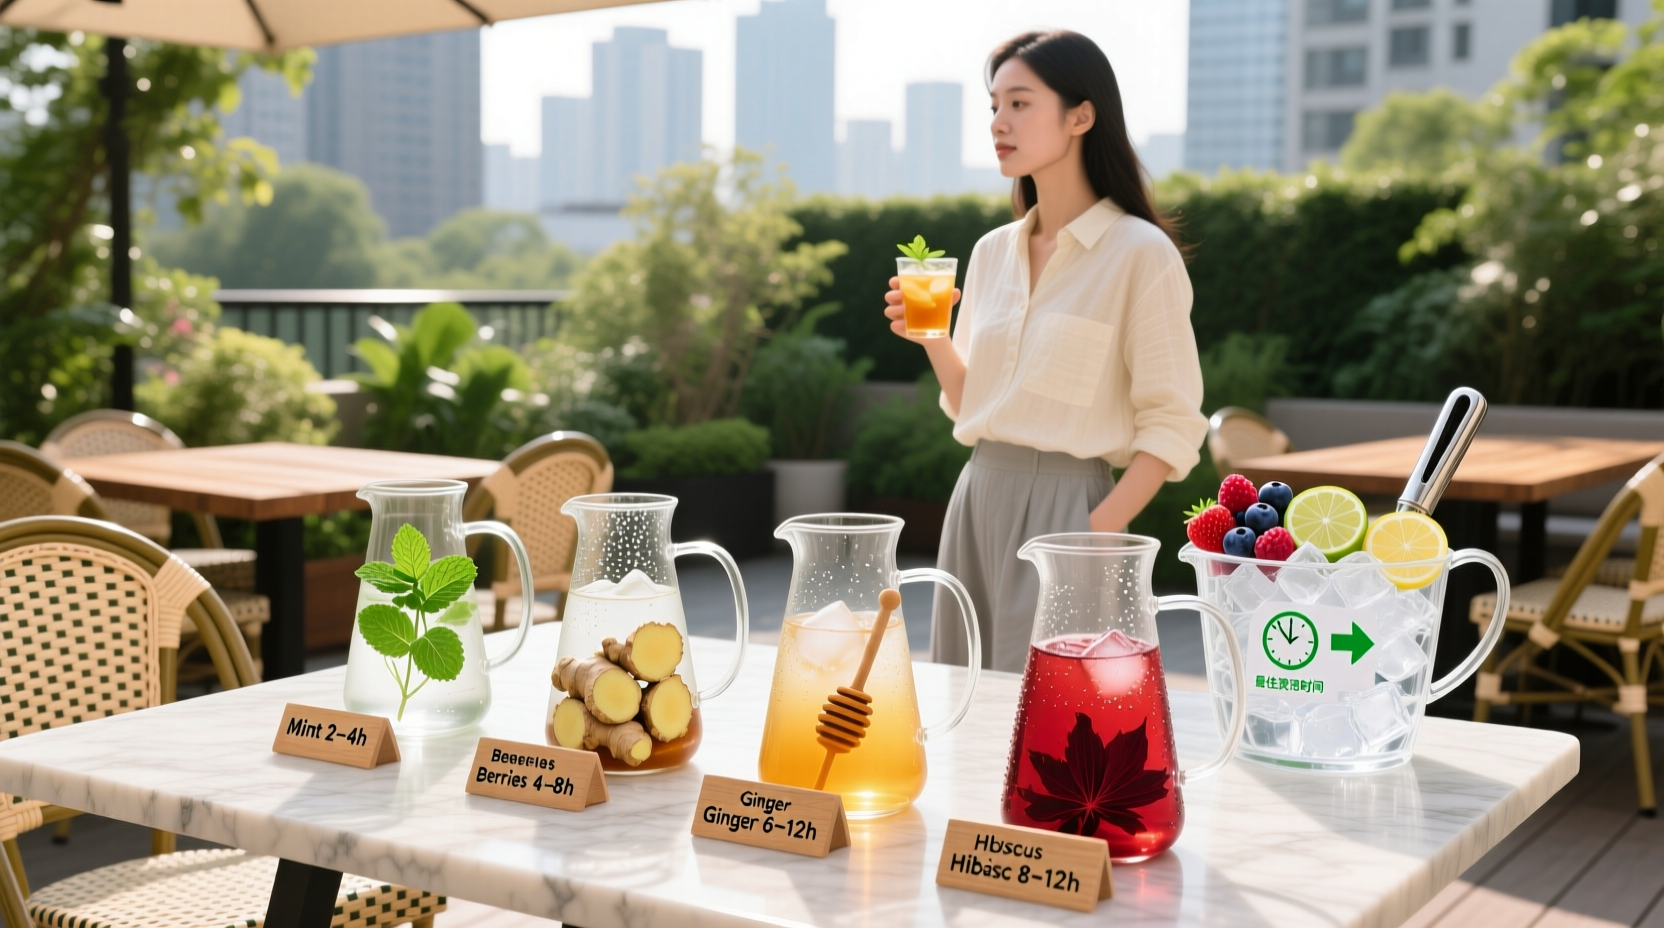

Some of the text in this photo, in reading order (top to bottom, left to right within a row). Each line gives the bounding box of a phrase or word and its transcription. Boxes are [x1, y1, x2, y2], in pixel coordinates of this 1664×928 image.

[286, 717, 323, 739] Mint
[476, 766, 528, 789] Berries
[740, 790, 792, 815] Ginger
[703, 805, 760, 833] Ginger
